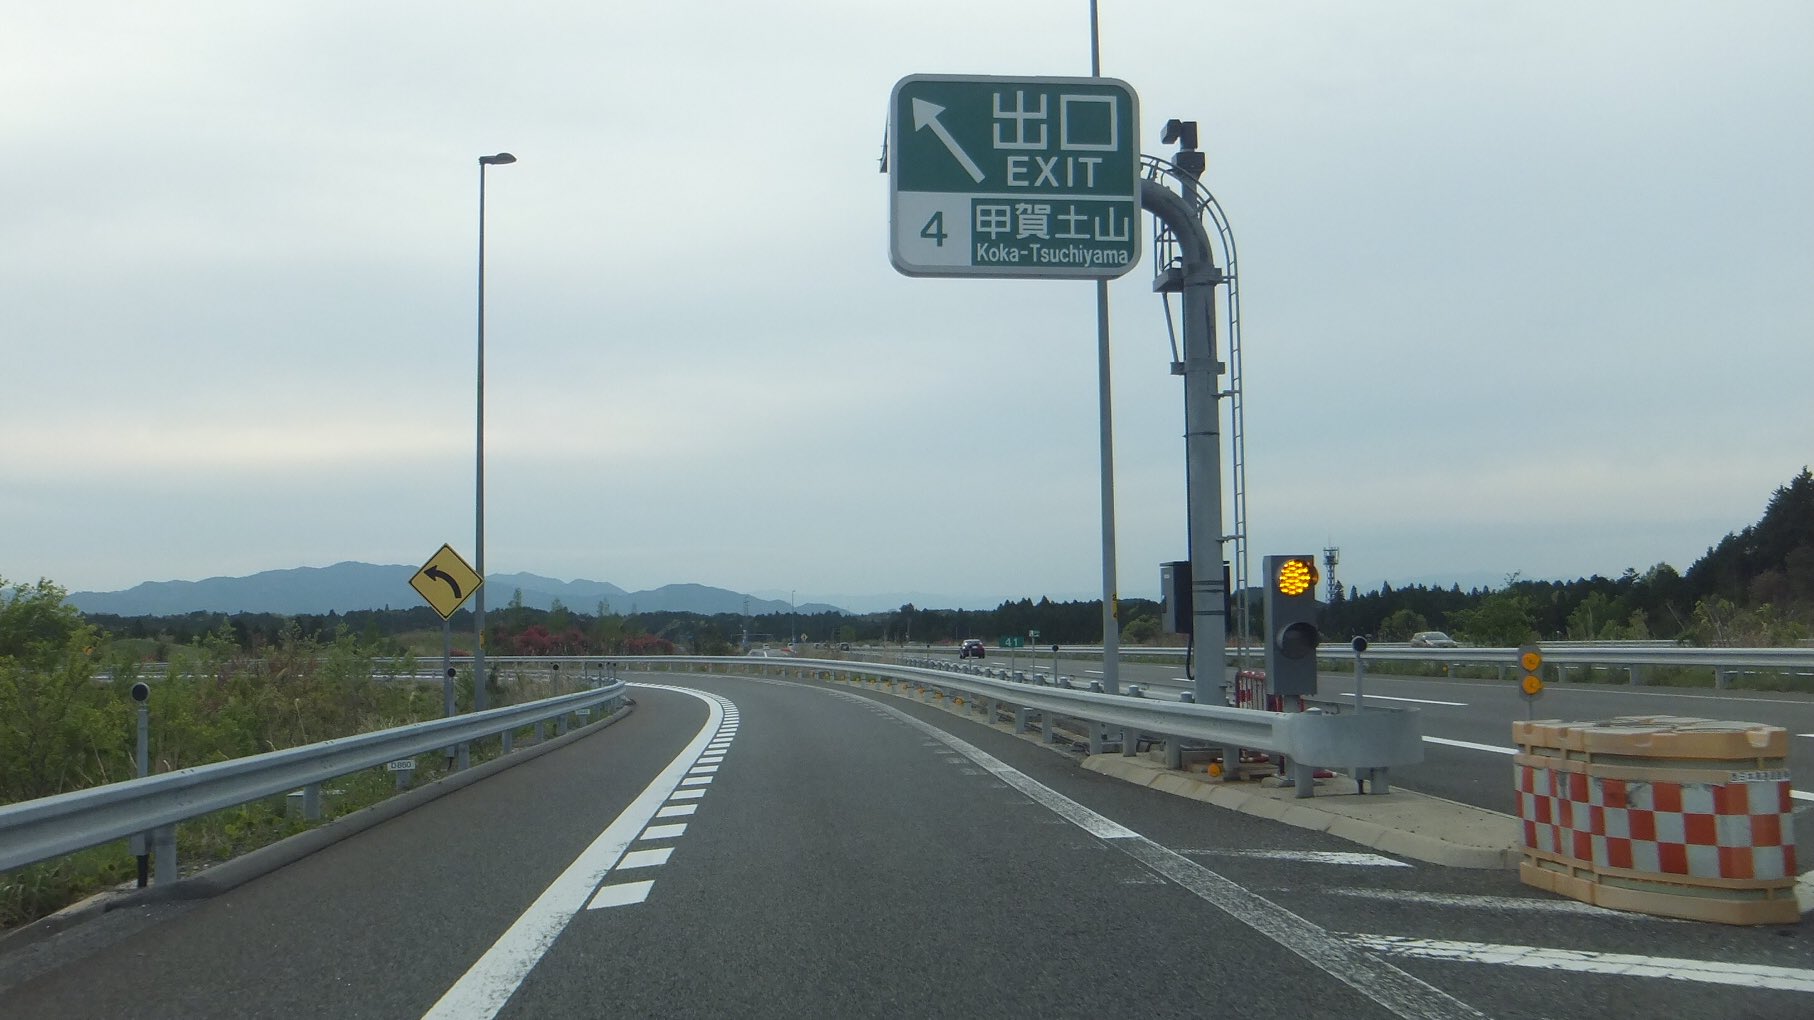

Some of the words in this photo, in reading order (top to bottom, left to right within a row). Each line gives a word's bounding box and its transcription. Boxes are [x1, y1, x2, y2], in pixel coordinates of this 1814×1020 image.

[993, 90, 1118, 152] 出口
[1007, 156, 1103, 188] EXIT
[920, 211, 948, 247] 4
[976, 202, 1129, 242] 甲賀土山
[976, 243, 1129, 267] Koka-Tsuchiyama
[1005, 637, 1018, 647] 41
